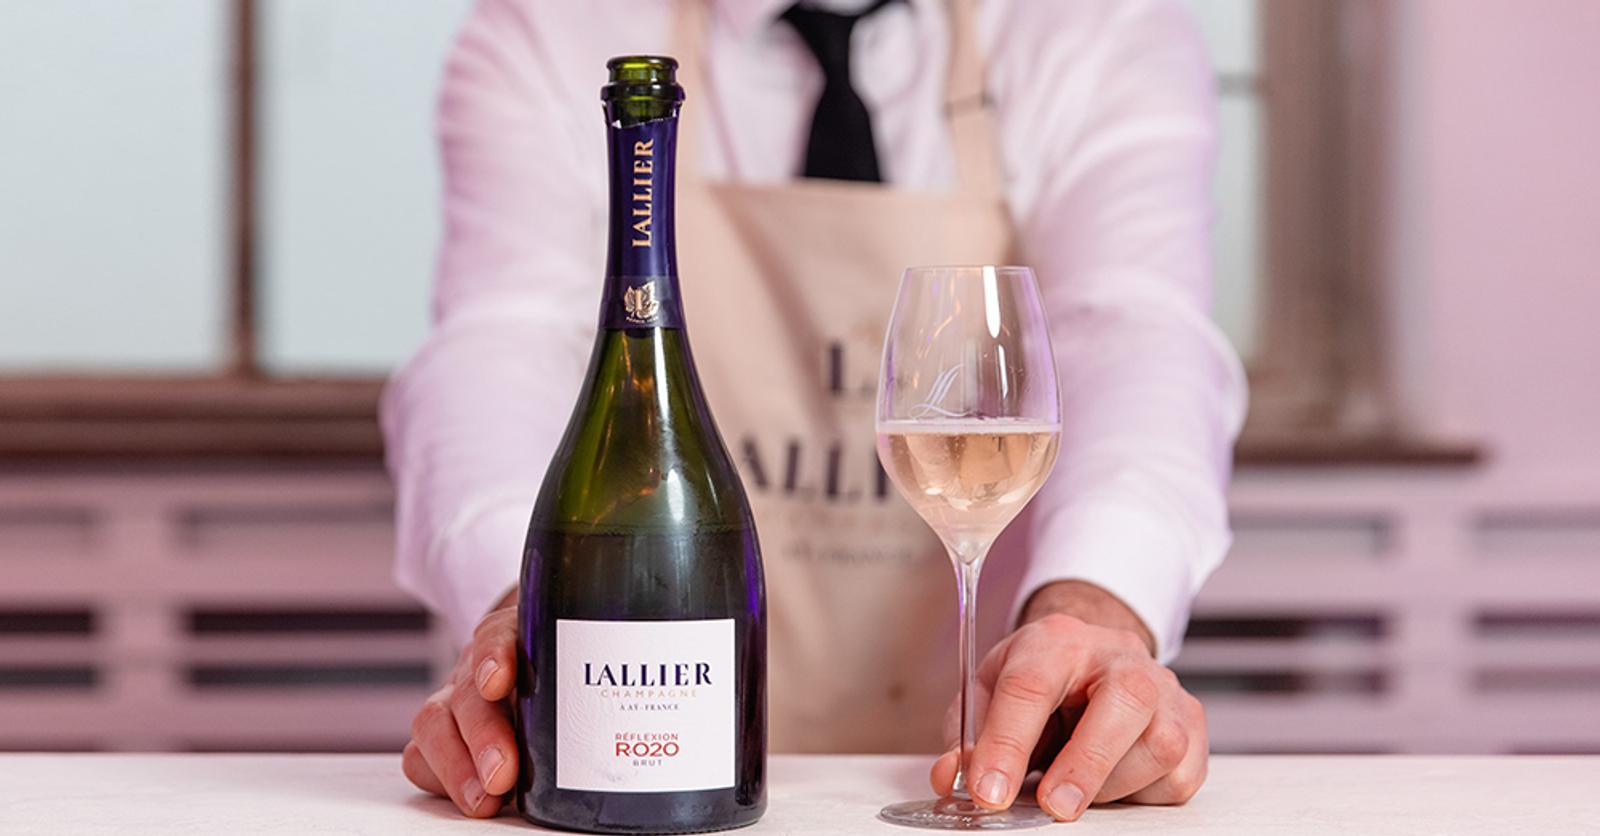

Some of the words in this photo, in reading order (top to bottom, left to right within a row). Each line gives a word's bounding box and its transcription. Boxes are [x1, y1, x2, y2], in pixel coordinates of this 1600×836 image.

[632, 138, 655, 248] LALLIER
[584, 662, 712, 687] LALLIER
[600, 689, 697, 699] CHAMPAGNE
[615, 731, 679, 741] RÉFLEXION
[632, 759, 662, 767] BRUT
